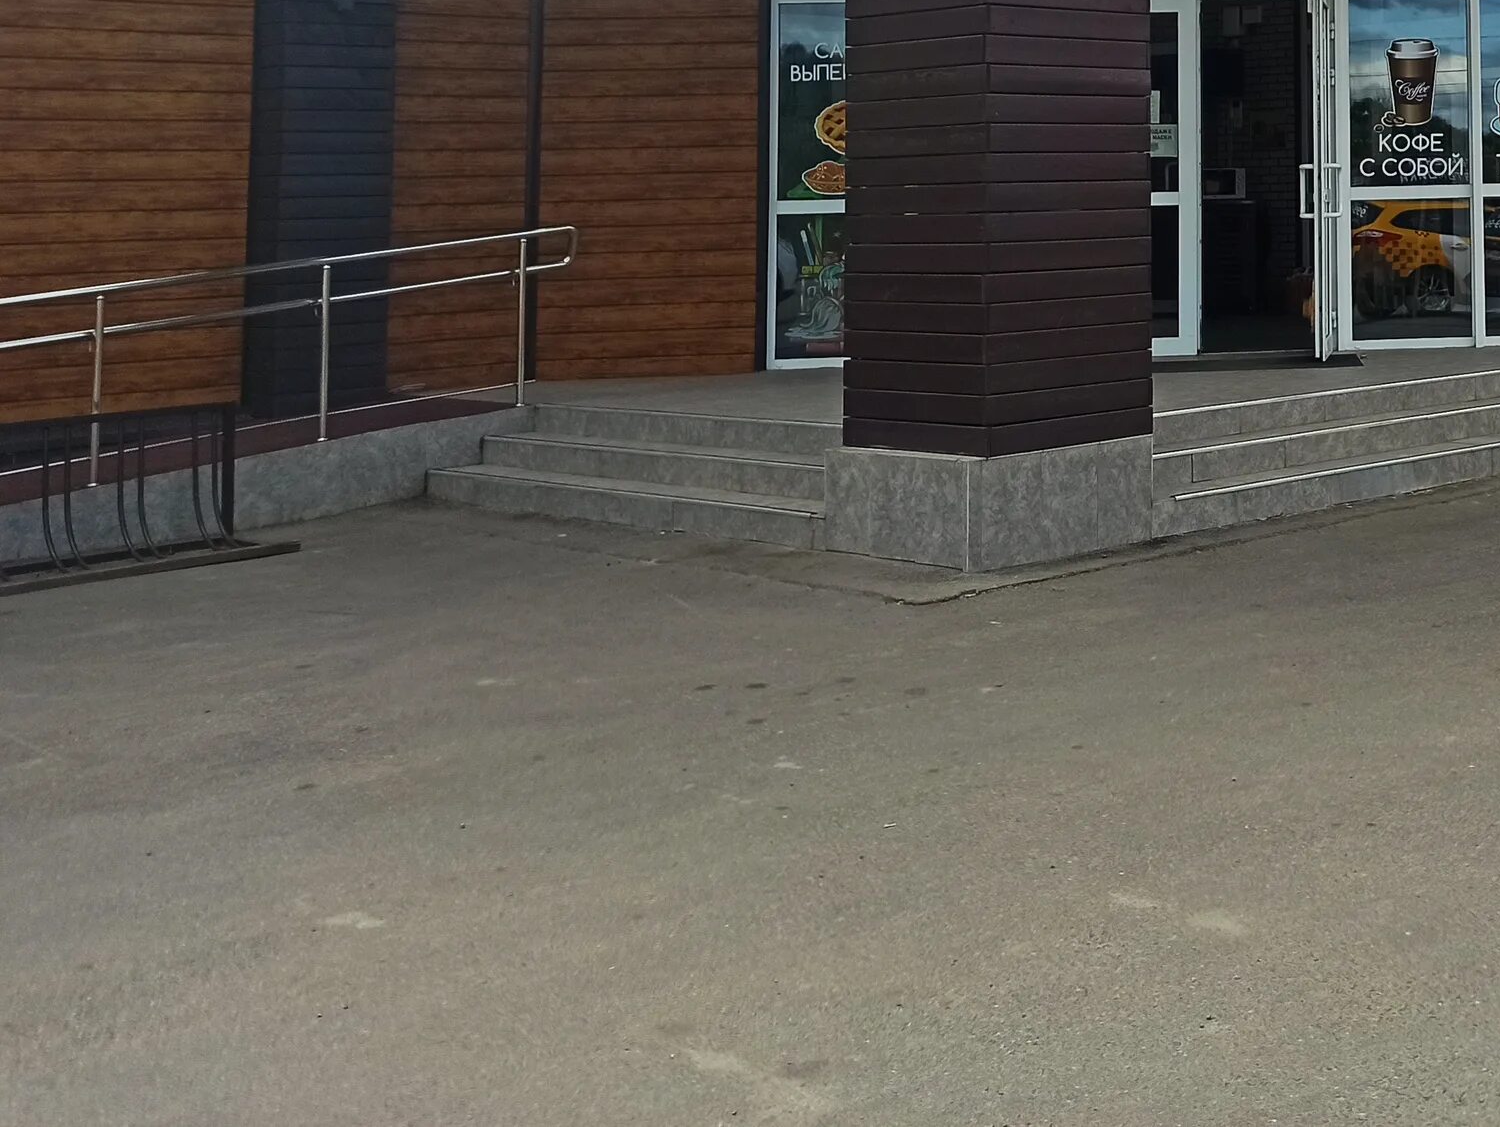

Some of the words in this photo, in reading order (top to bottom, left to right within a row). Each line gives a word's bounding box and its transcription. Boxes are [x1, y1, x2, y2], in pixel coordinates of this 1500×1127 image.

[1395, 79, 1430, 101] Coffee
[1378, 133, 1444, 153] КОФЕ
[1359, 157, 1376, 177] С
[1381, 152, 1464, 177] СОБОЙ
